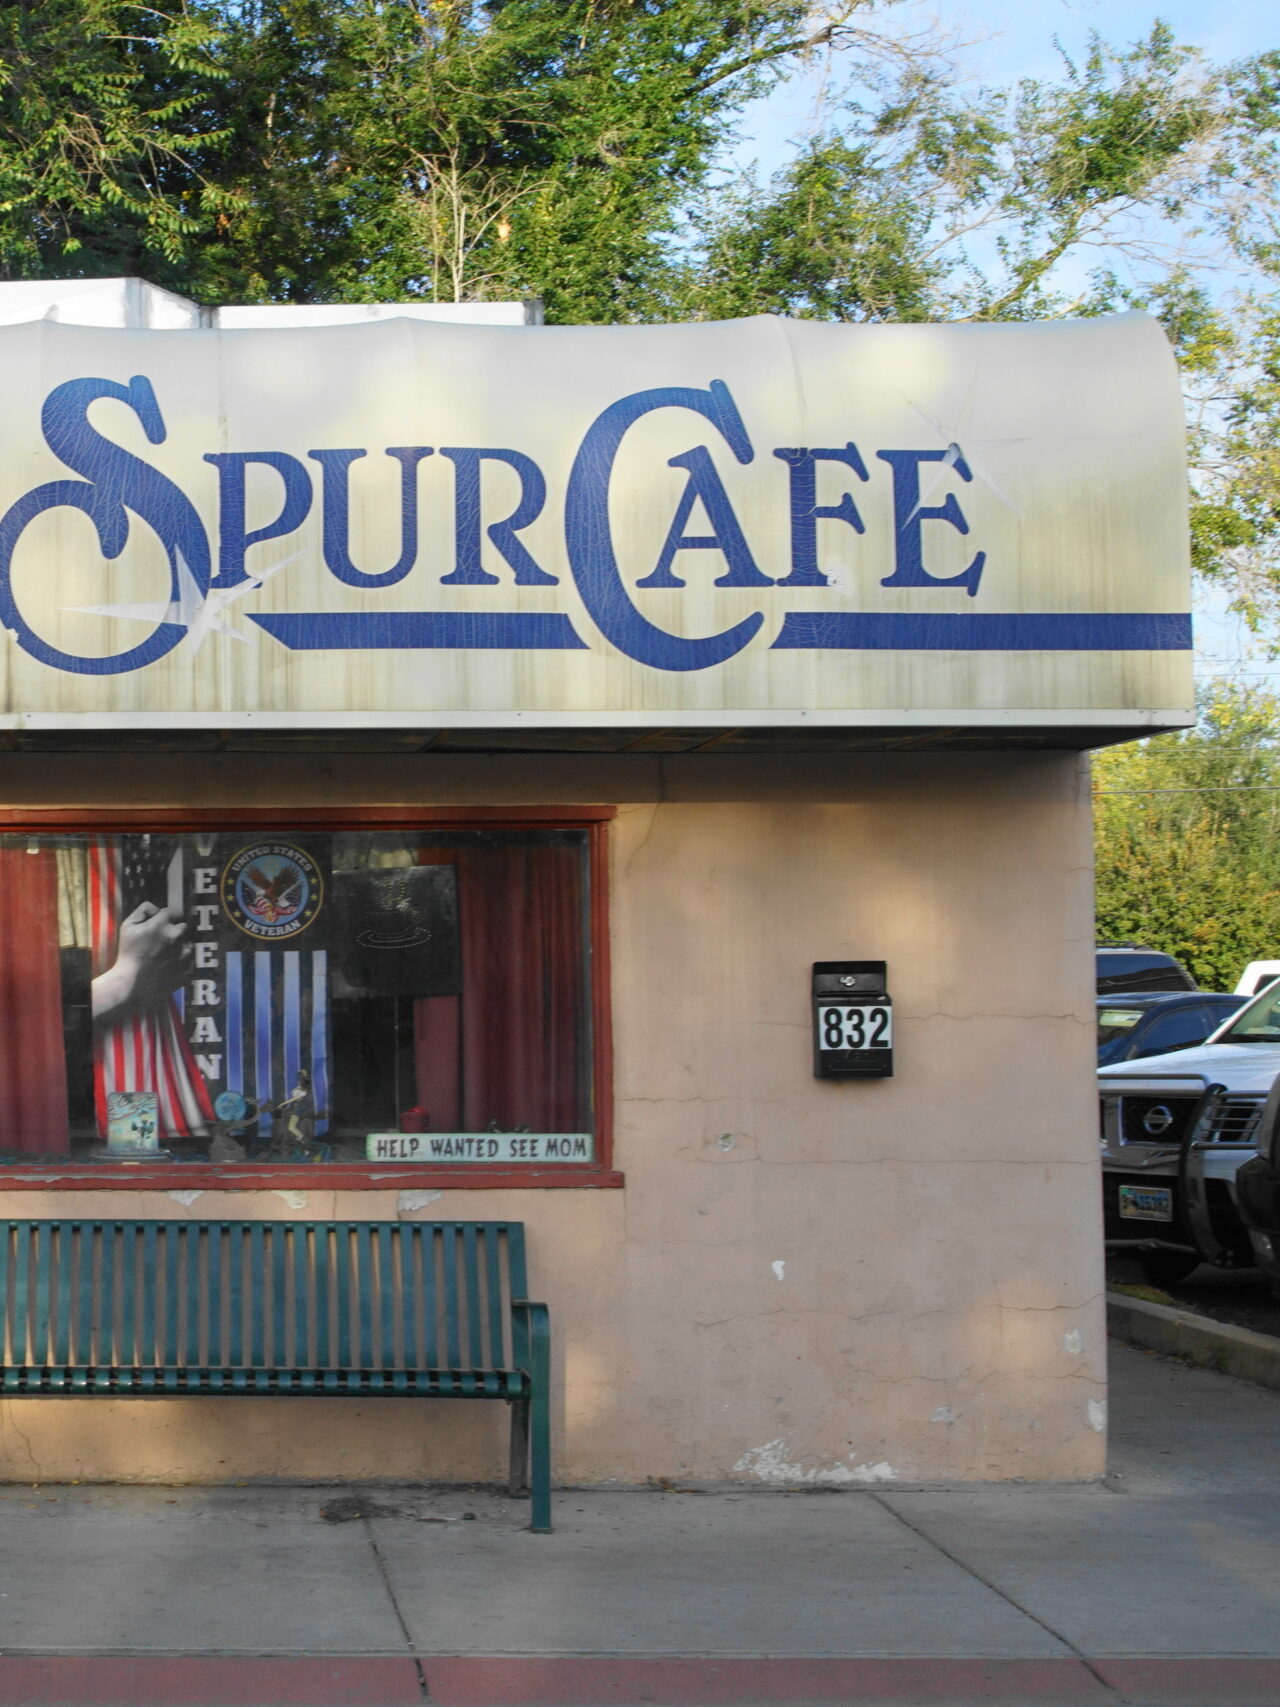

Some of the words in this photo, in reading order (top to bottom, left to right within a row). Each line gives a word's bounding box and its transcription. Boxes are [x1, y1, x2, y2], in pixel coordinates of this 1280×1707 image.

[564, 378, 987, 672] CAFE
[231, 845, 271, 872] UNITED
[272, 845, 313, 872] STATES
[244, 919, 301, 937] VETERAN
[189, 834, 223, 1080] VETERAN
[824, 1007, 888, 1049] 832
[376, 1137, 420, 1158] HELP
[430, 1138, 499, 1158] WANTED
[509, 1138, 539, 1158] SEE
[545, 1137, 587, 1158] MOM
